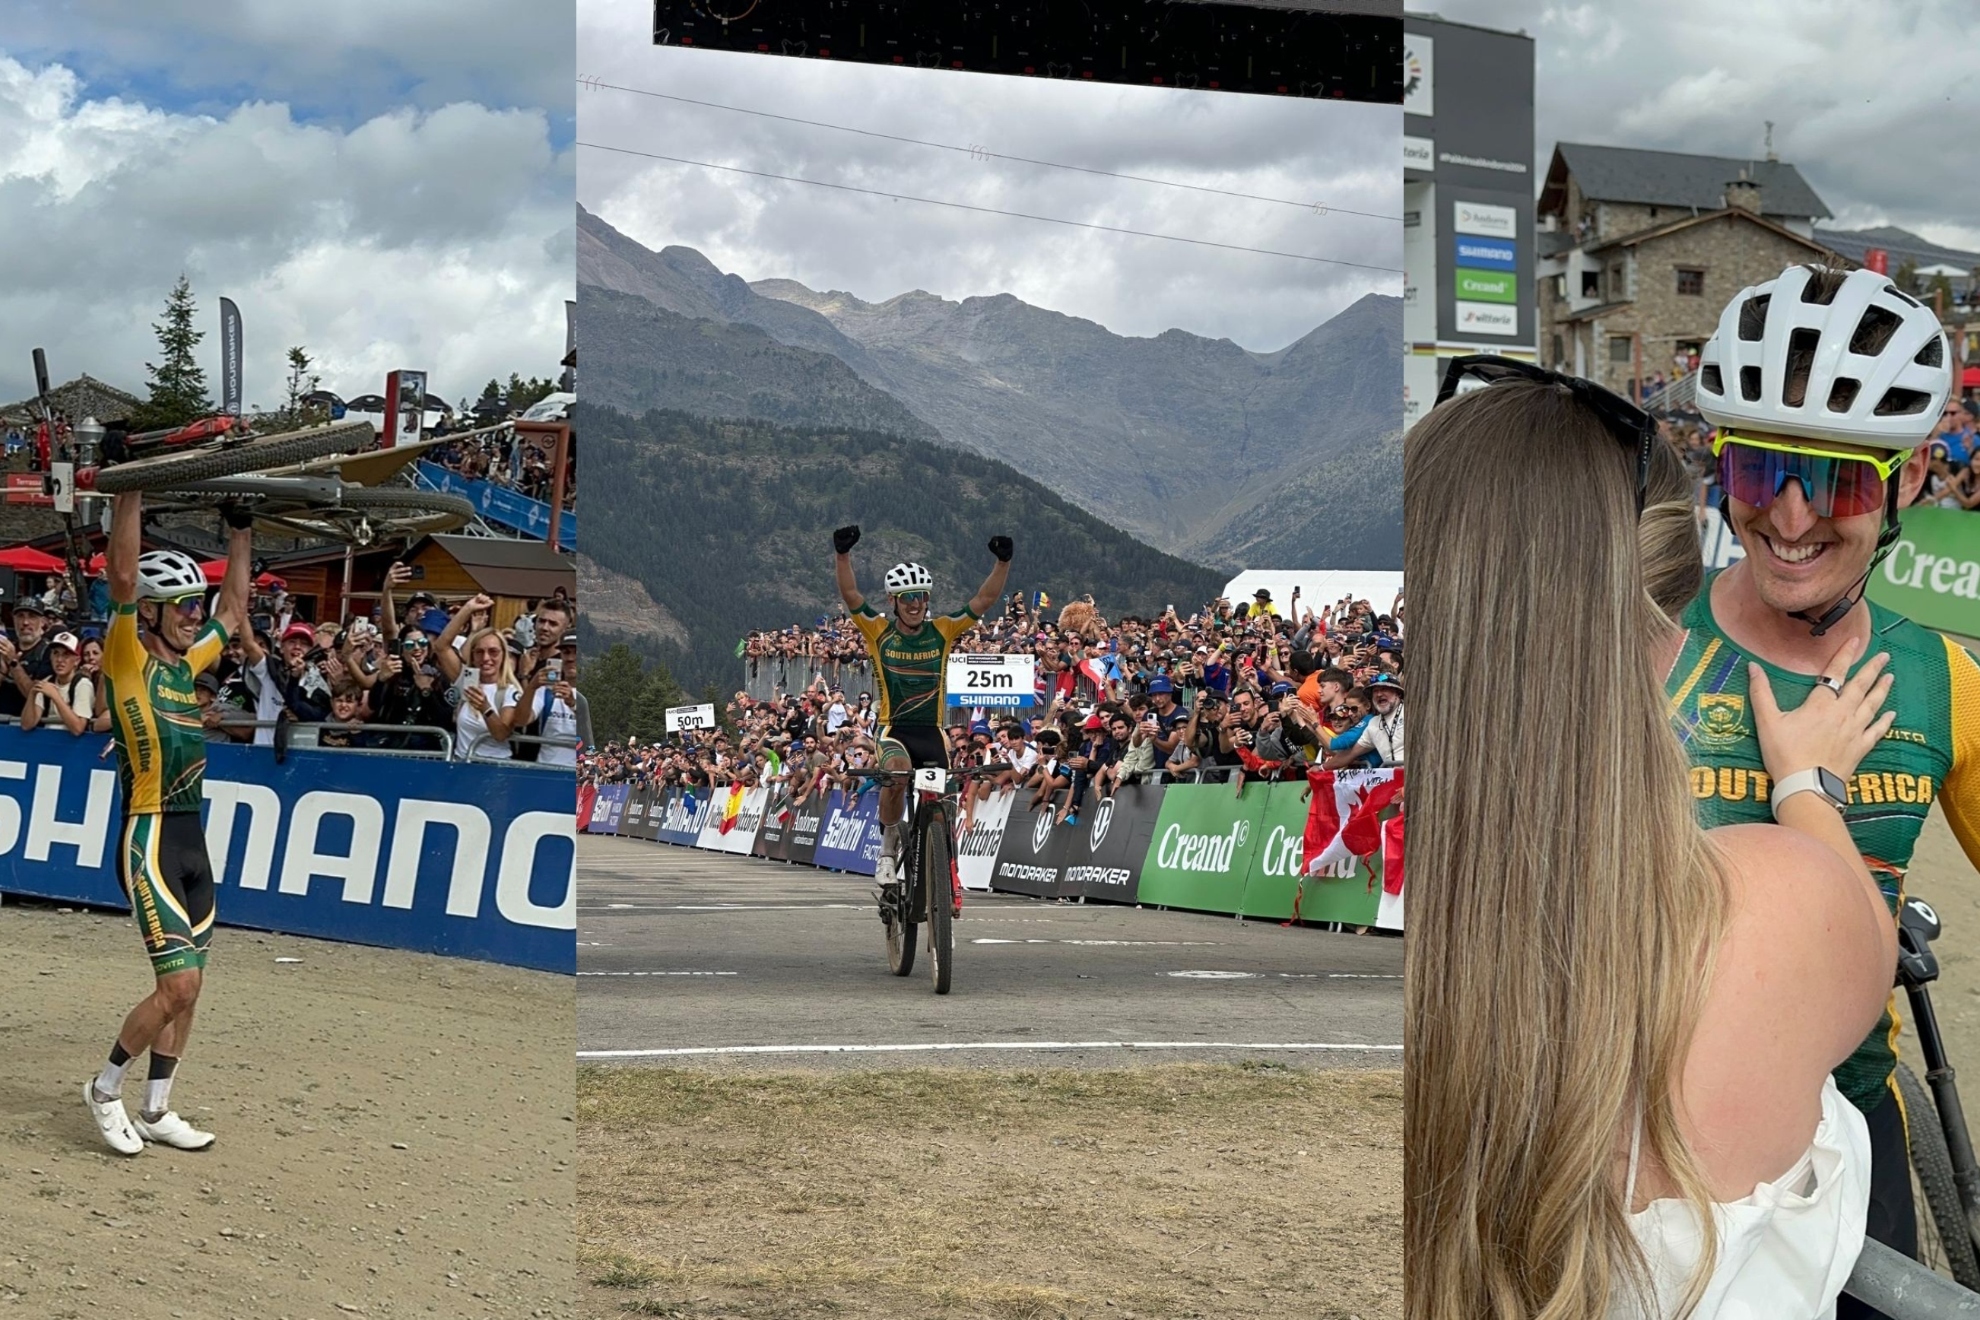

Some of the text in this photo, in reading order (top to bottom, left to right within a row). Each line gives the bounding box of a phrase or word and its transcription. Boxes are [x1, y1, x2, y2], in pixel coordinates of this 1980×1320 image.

[1459, 245, 1513, 261] SHIMANO
[1463, 279, 1505, 294] Creand
[885, 648, 940, 660] SOUTH AFRICA
[952, 656, 966, 664] UCI
[967, 670, 1013, 688] 25m
[959, 695, 1020, 705] SHIMANO
[677, 715, 704, 727] 50m
[123, 697, 152, 773] SOUTH AFRICA
[1884, 729, 1927, 744] VITA
[925, 770, 937, 781] 3
[821, 808, 867, 851] Santini
[959, 818, 1003, 857] vittoria
[1157, 819, 1242, 873] Creand
[999, 862, 1058, 883] MONDRAKER
[1064, 865, 1131, 886] MONDRAKER
[138, 876, 167, 949] SOUTH AFRICA
